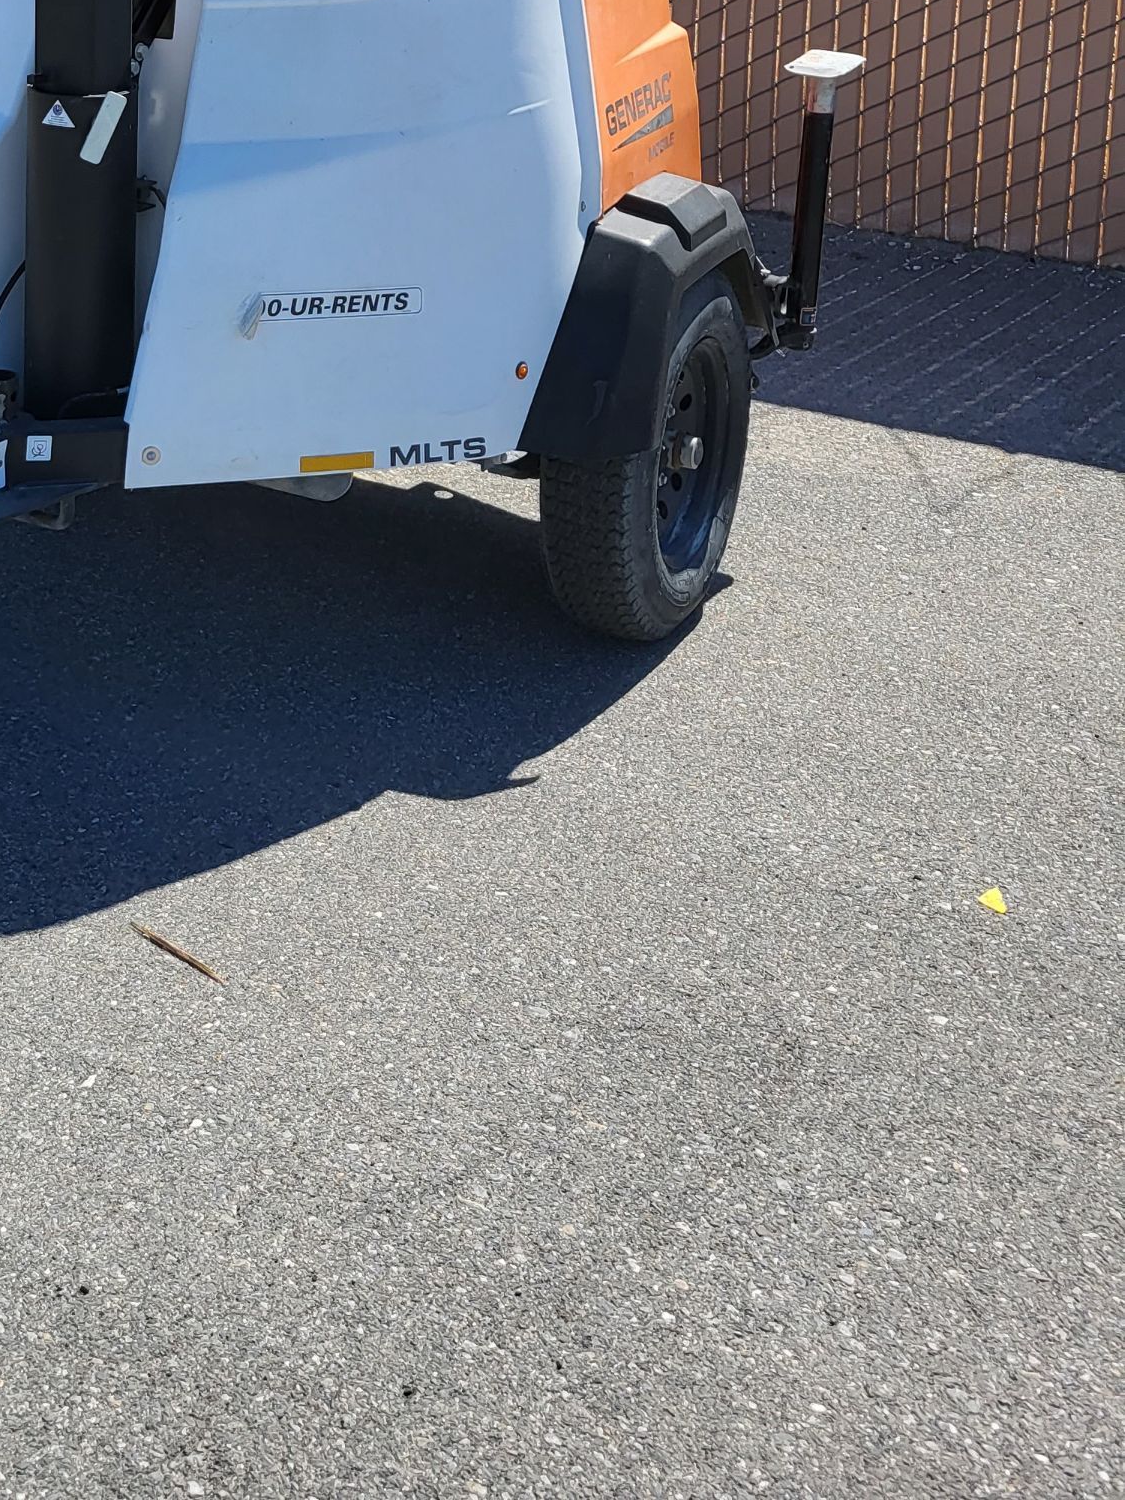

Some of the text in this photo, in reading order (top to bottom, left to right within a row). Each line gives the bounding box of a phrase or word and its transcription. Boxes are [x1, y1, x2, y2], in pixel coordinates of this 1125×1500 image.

[605, 71, 671, 137] GENERAC
[261, 292, 410, 317] 0-UR-RENTS
[390, 436, 487, 467] MLTS
